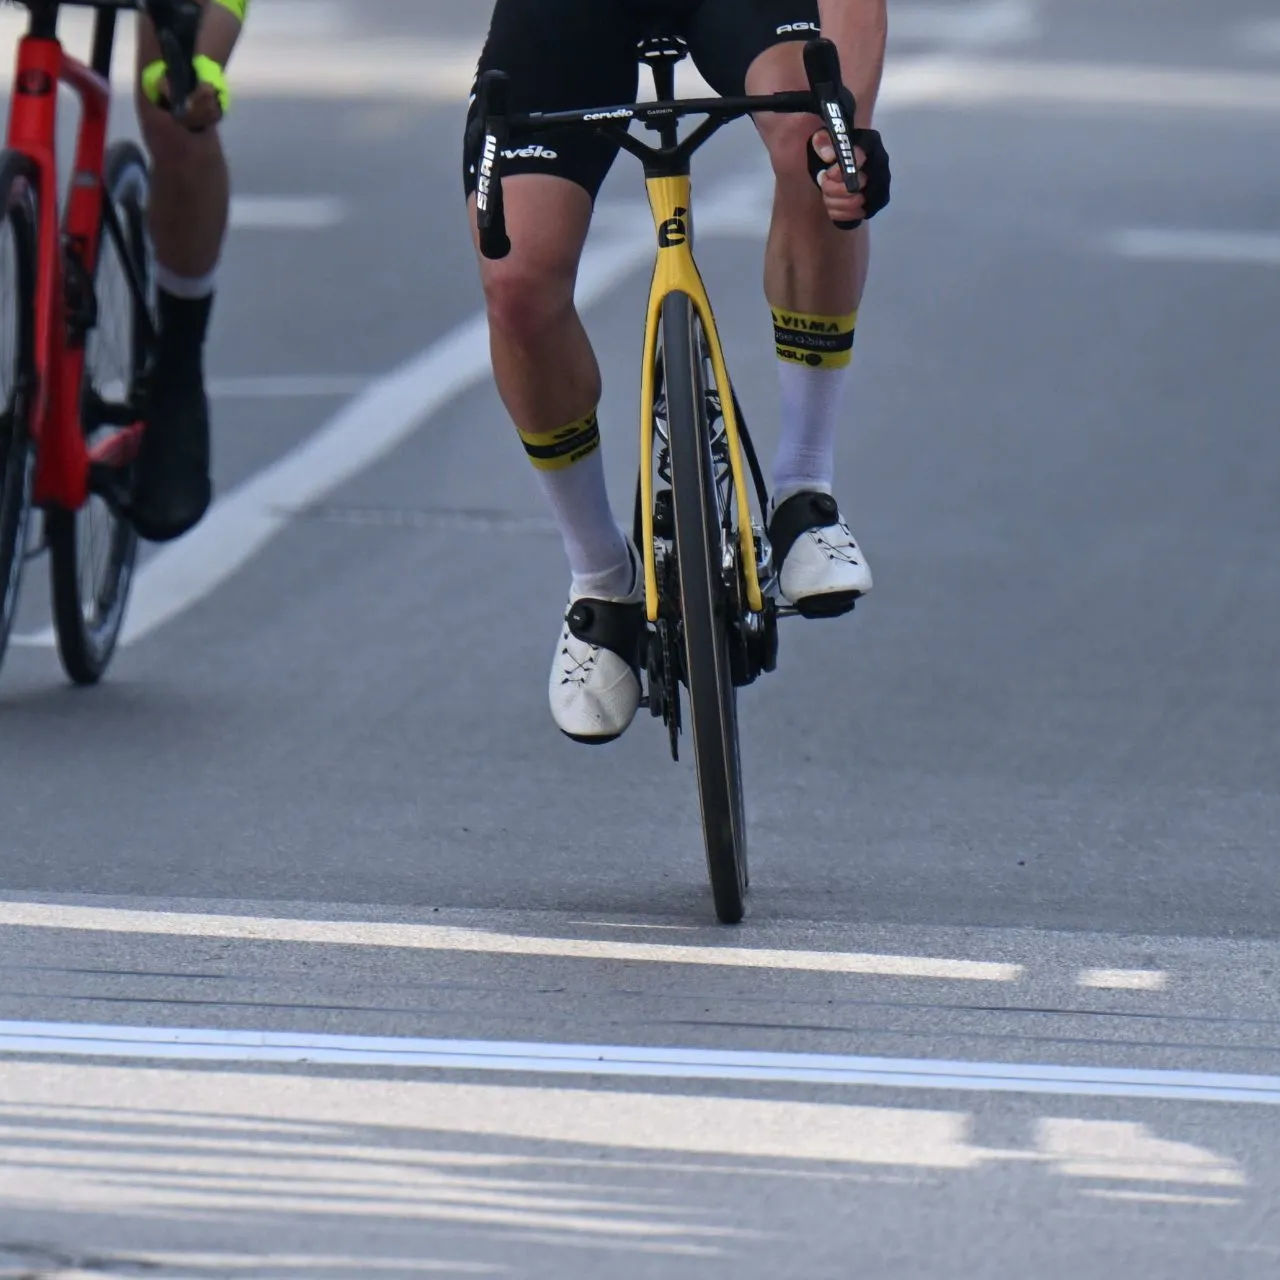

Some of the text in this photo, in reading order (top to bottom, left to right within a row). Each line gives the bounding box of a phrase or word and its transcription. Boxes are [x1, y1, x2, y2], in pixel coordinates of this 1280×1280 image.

[583, 108, 634, 121] cervélo
[826, 102, 856, 174] SRAM
[500, 145, 558, 159] vélo
[476, 134, 497, 211] SRAM
[780, 315, 839, 332] VISMA
